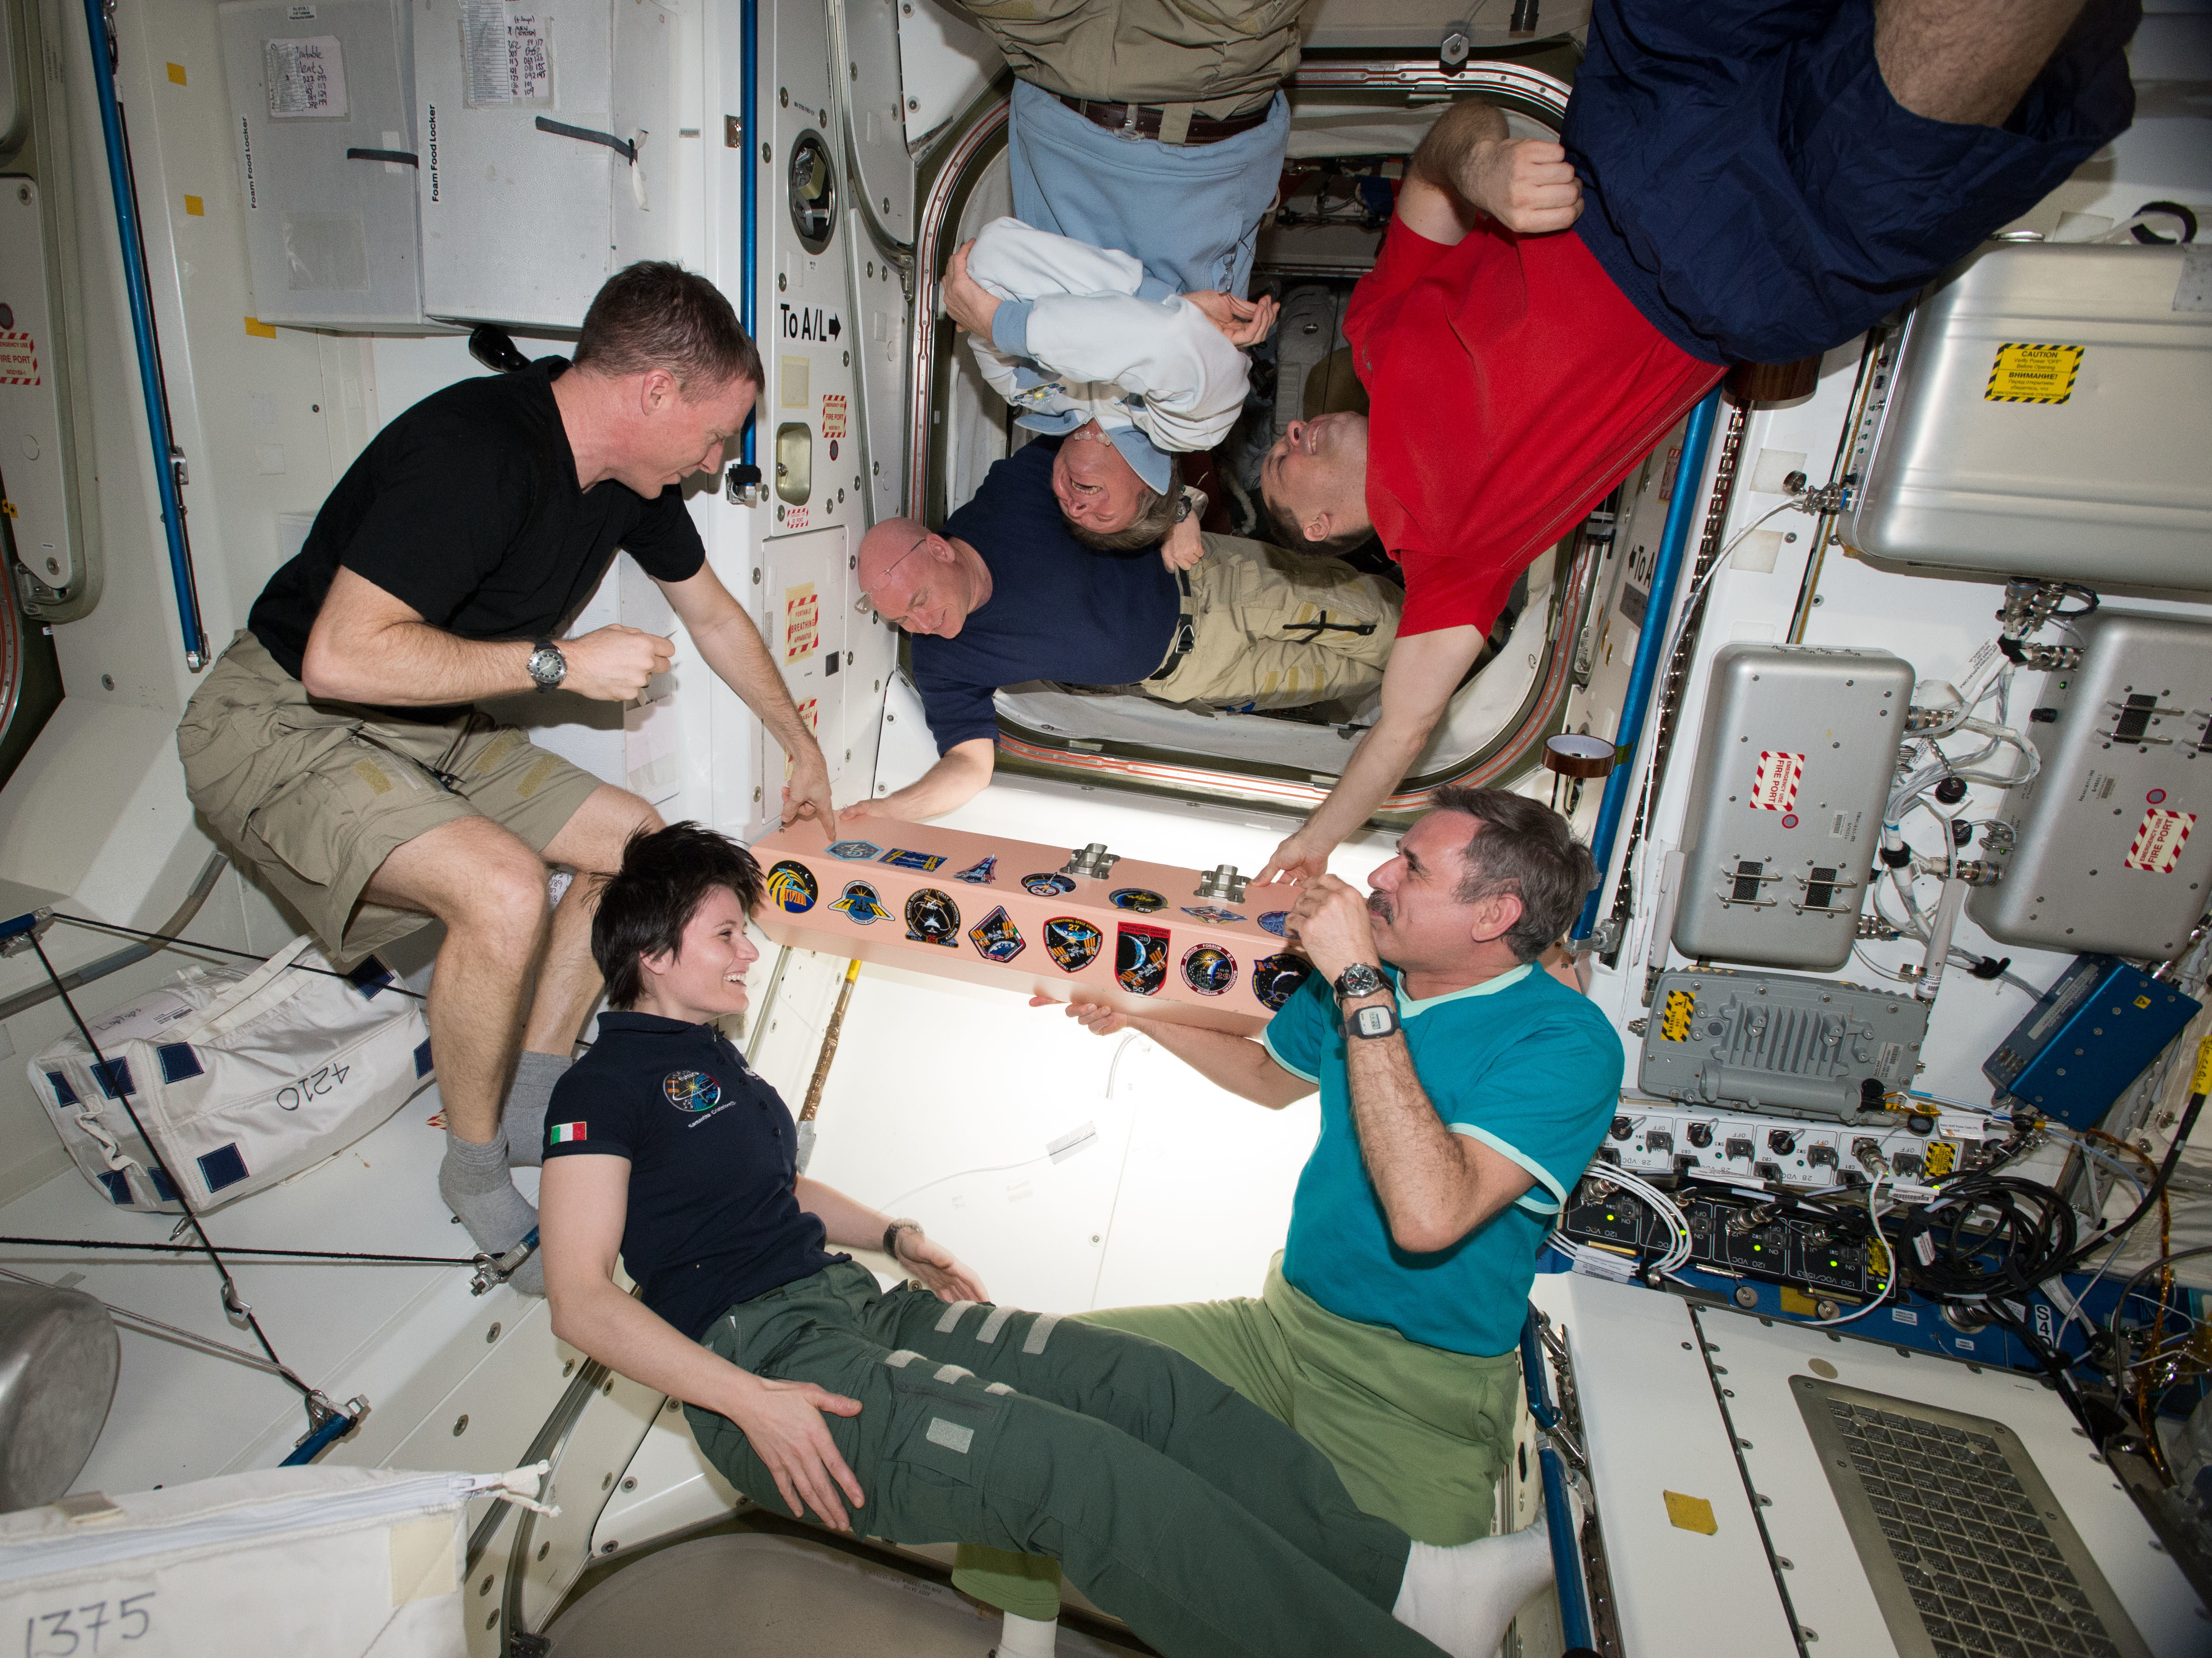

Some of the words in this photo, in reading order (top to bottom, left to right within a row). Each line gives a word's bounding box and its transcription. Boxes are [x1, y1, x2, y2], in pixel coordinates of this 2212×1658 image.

[242, 117, 251, 152] Locker
[780, 303, 798, 338] To
[801, 307, 827, 342] A/L
[0, 354, 11, 363] IRE
[13, 355, 30, 363] PORT
[2009, 372, 2058, 380] ВНИМАНИЕ!
[1635, 545, 1645, 582] To
[795, 608, 811, 617] PORTABLE
[791, 618, 815, 633] BREATHING
[794, 632, 811, 643] APPARATUS
[1773, 760, 1785, 778] FIRE
[1781, 760, 1792, 793] EMERGENCY
[1768, 780, 1780, 803] PORT
[2139, 830, 2157, 861] EMERGENCY
[2155, 817, 2163, 828] USE
[2147, 844, 2163, 863] FIRE
[2157, 818, 2174, 843] PORT
[910, 890, 929, 901] WHEELOCK
[938, 891, 949, 900] KELLY
[1086, 923, 1098, 934] STATION
[1183, 946, 1198, 960] ВОЛКОВ
[1057, 960, 1069, 971] NESPOLI
[1181, 965, 1193, 988] ИВАНИШИН
[1215, 972, 1231, 980] 29
[1119, 979, 1131, 992] ГАГАРИН
[1145, 986, 1159, 996] SHEPARD
[93, 1007, 142, 1031] Laptops
[276, 1062, 350, 1112] 4210
[688, 1113, 711, 1129] Samantha
[1604, 1230, 1618, 1238] 120
[1731, 1256, 1748, 1265] VDC
[1752, 1260, 1766, 1269] 120
[1797, 1270, 1837, 1283] VDC/1553
[1840, 1279, 1855, 1287] 120
[26, 1592, 156, 1658] 1375
